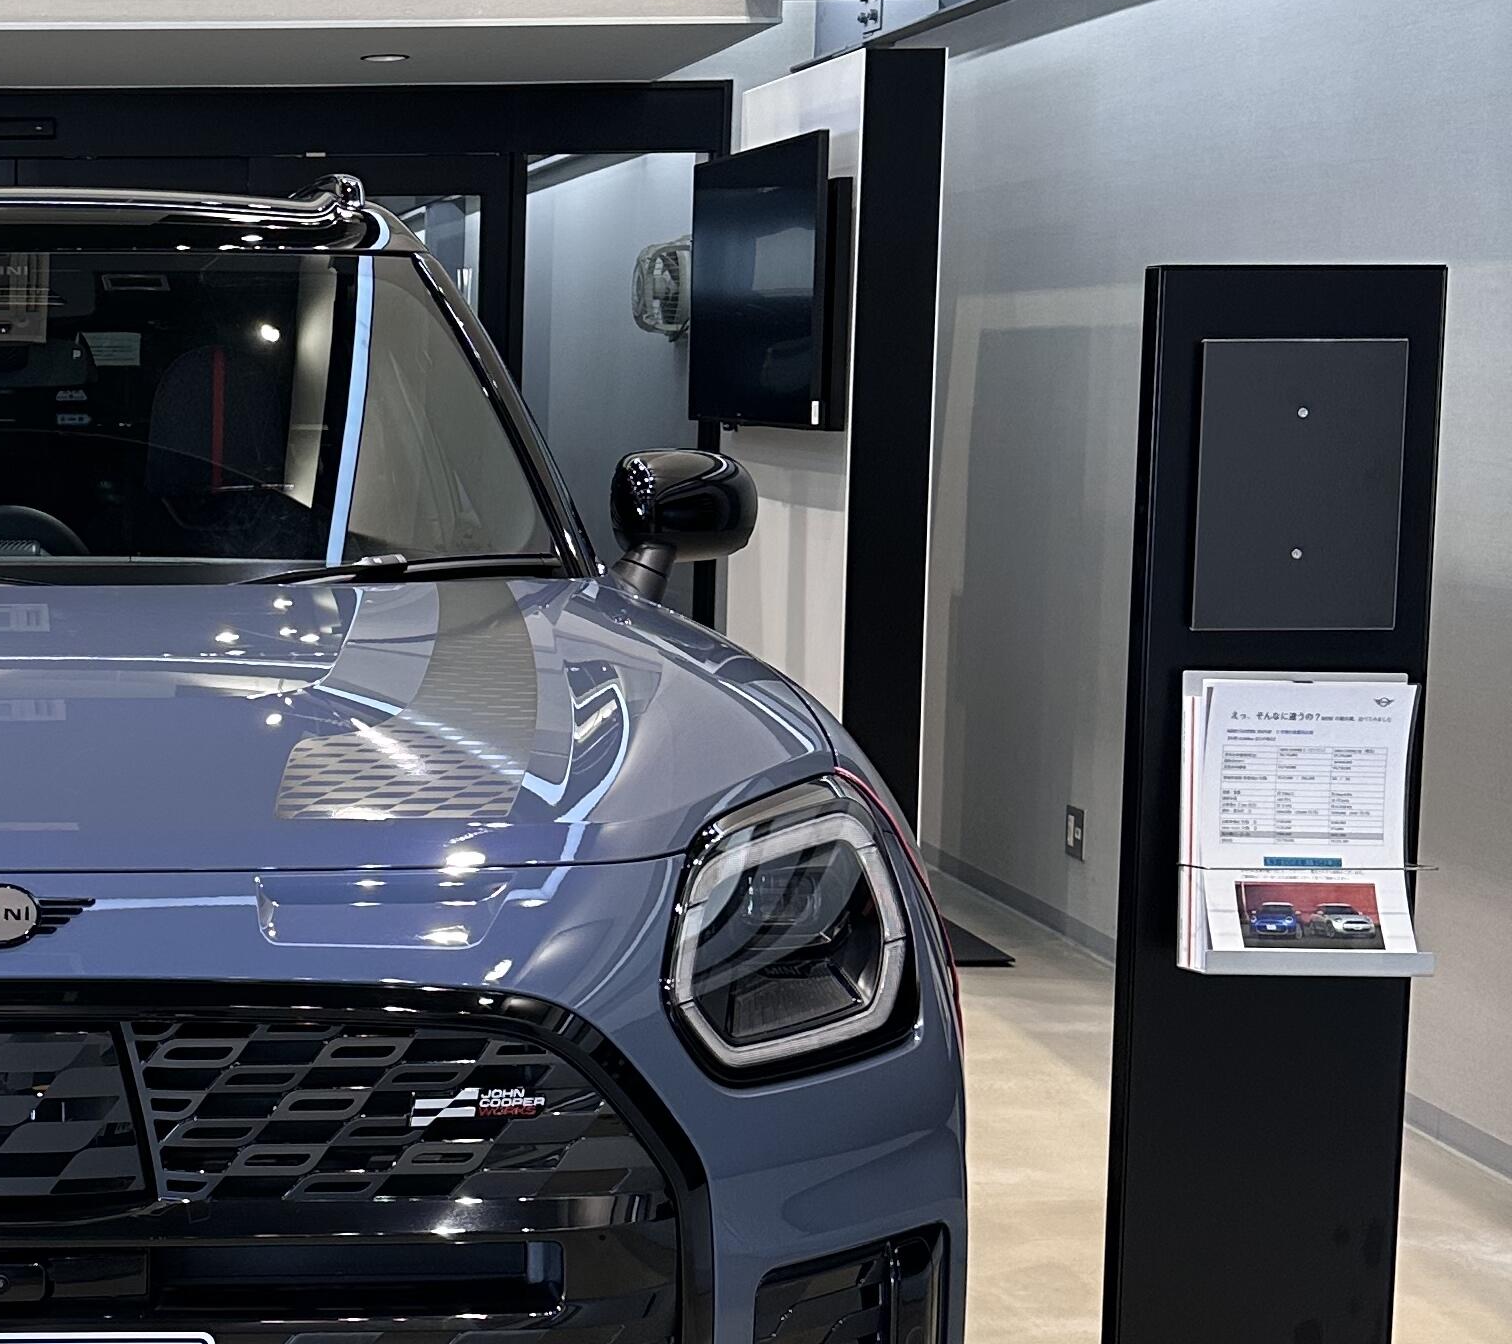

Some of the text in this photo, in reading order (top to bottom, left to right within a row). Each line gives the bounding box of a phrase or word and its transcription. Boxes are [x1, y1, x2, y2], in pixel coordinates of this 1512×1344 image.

[480, 1088, 525, 1098] JOHN
[479, 1097, 545, 1107] COOPER
[479, 1106, 537, 1116] WORKS
